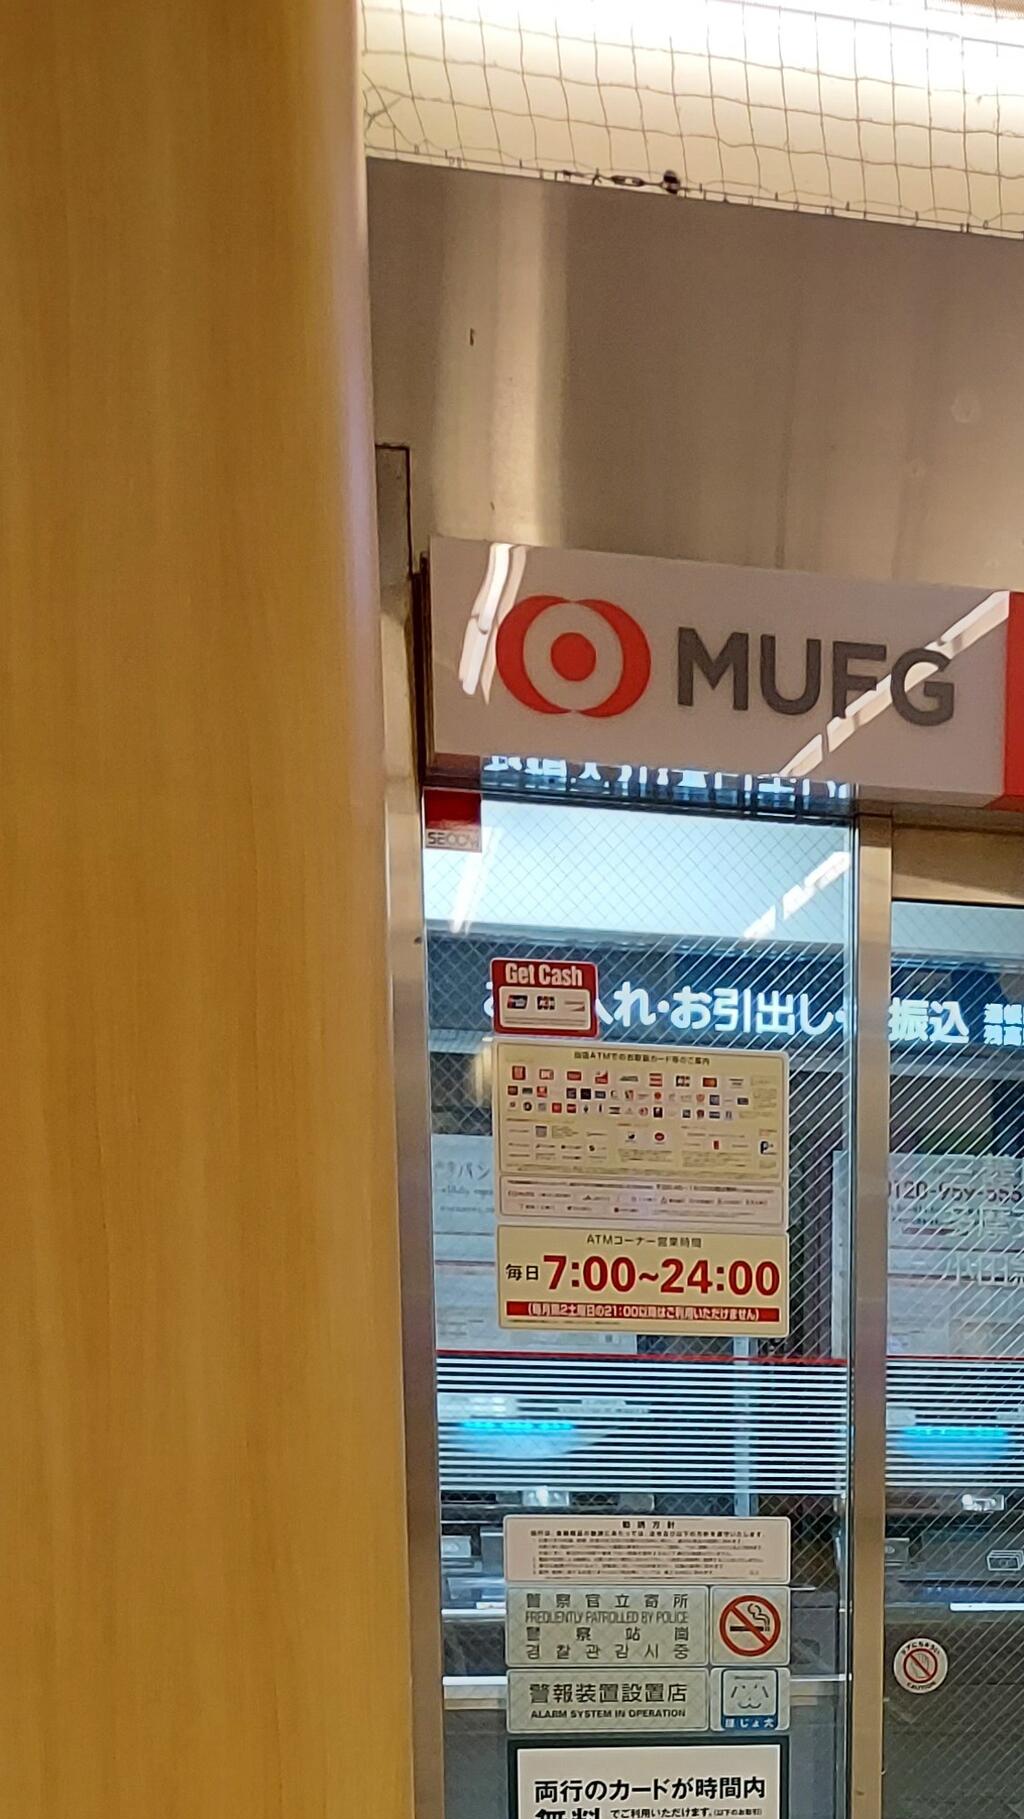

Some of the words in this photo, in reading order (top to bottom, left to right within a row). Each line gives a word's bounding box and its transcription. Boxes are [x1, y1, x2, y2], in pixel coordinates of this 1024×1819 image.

[677, 627, 956, 727] MUFG
[505, 962, 536, 985] Get
[538, 964, 583, 987] Cash
[586, 1234, 702, 1248] ATMコーナー営業時間
[505, 1264, 539, 1281] 毎日
[586, 1611, 639, 1624] PATROLLED
[641, 1611, 654, 1624] BY
[656, 1611, 689, 1624] POLICE
[529, 1683, 689, 1704] 警報装置設置店
[531, 1709, 568, 1719] ALARM
[570, 1709, 611, 1719] SYSTEM
[615, 1709, 627, 1719] IN
[629, 1708, 686, 1719] OPERATION
[534, 1776, 766, 1804] 両行のカードが時間内
